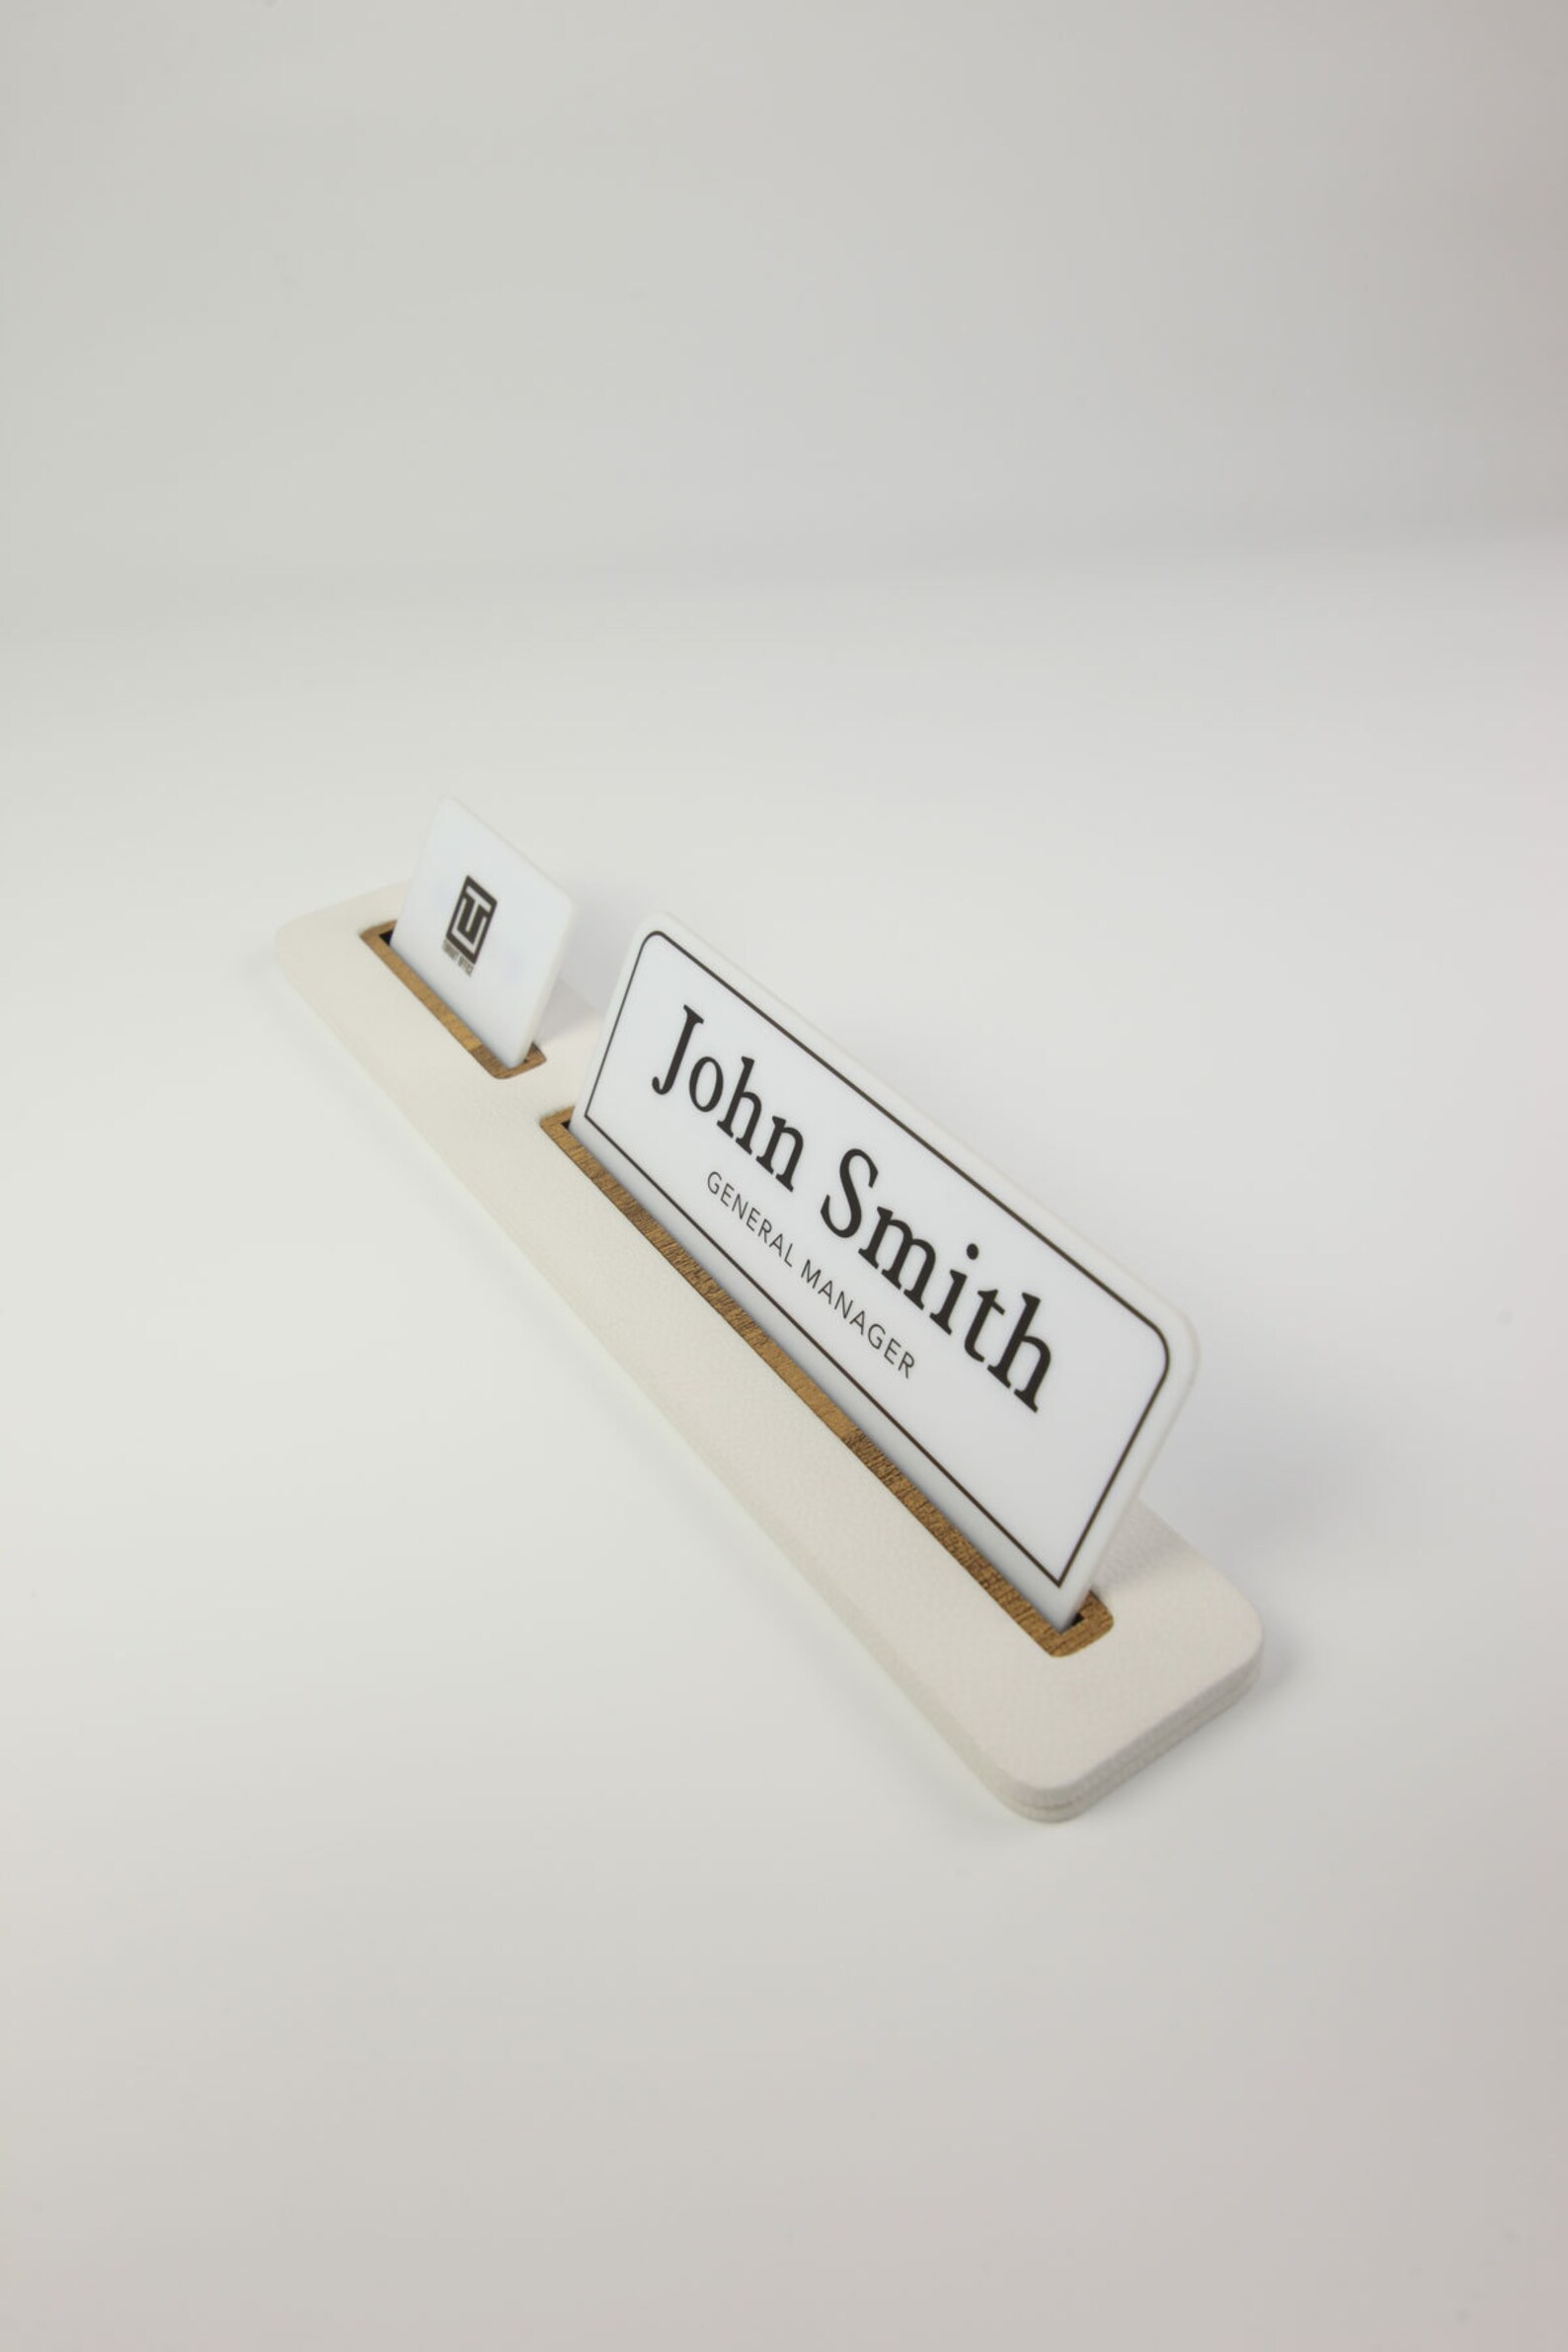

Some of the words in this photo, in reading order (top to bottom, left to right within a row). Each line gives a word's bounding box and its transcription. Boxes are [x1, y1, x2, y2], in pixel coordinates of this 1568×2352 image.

[651, 1004, 804, 1193] John
[820, 1147, 1052, 1414] Smith
[706, 1170, 793, 1269] GENERAL
[800, 1258, 916, 1379] MANAGER
